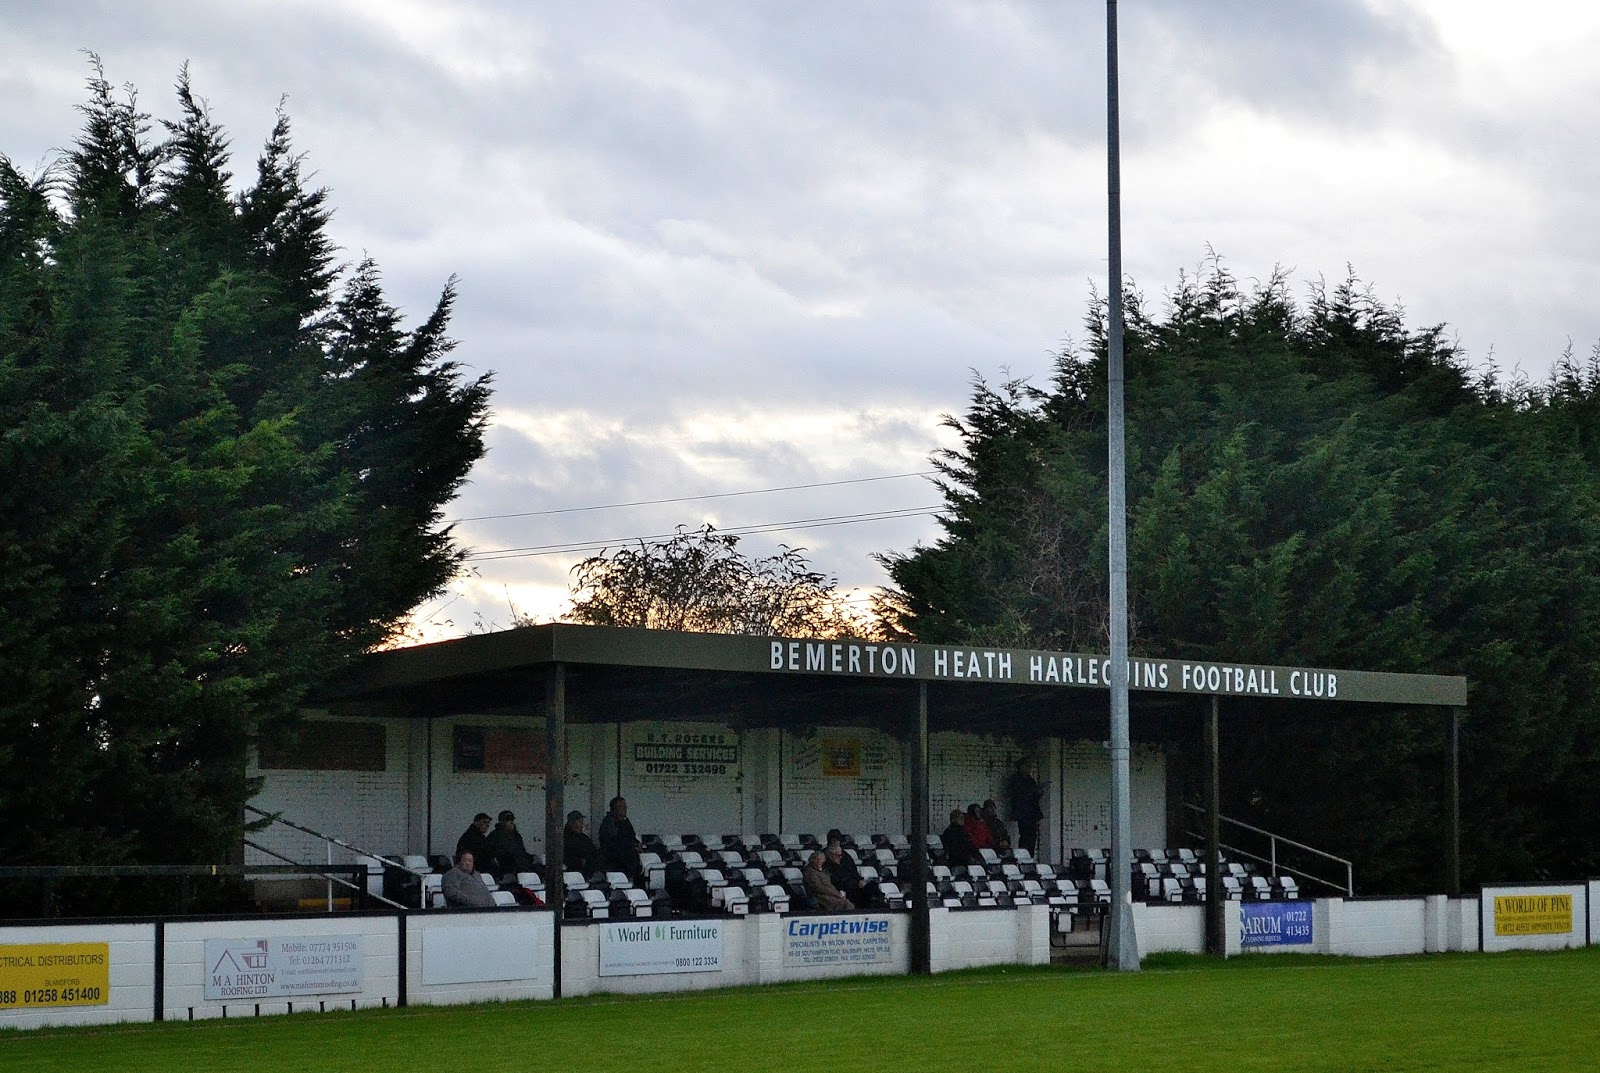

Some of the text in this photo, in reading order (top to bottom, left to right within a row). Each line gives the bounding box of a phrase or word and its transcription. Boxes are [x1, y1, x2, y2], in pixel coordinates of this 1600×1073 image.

[770, 641, 1338, 698] BEMERTON HEATH HARLEQINS FOOTBALL CLUB
[636, 745, 736, 760] BUILDING SERVICES
[646, 763, 678, 774] 01722
[1496, 896, 1571, 914] A WORLD OF PINE
[1286, 911, 1307, 922] 01722
[618, 926, 650, 942] World
[670, 924, 718, 941] Furniture
[788, 917, 889, 940] Carpetwise
[1286, 925, 1310, 937] 413435
[281, 942, 308, 953] Mobile:
[309, 943, 331, 953] 07774
[789, 940, 820, 949] SPECIALISTS
[862, 937, 889, 945] CARPETING
[0, 954, 104, 968] TRICAL DISTRIBUTORS
[288, 956, 301, 966] Tel:
[302, 956, 324, 965] 01264
[676, 957, 690, 967] 0800
[692, 957, 702, 966] 122
[704, 956, 718, 966] 3334
[45, 978, 80, 987] BLANDFORD
[212, 973, 275, 987] M A HINTON
[24, 988, 58, 1003] 01258
[61, 987, 100, 1001] 451400
[221, 985, 268, 996] ROOFING LTD
